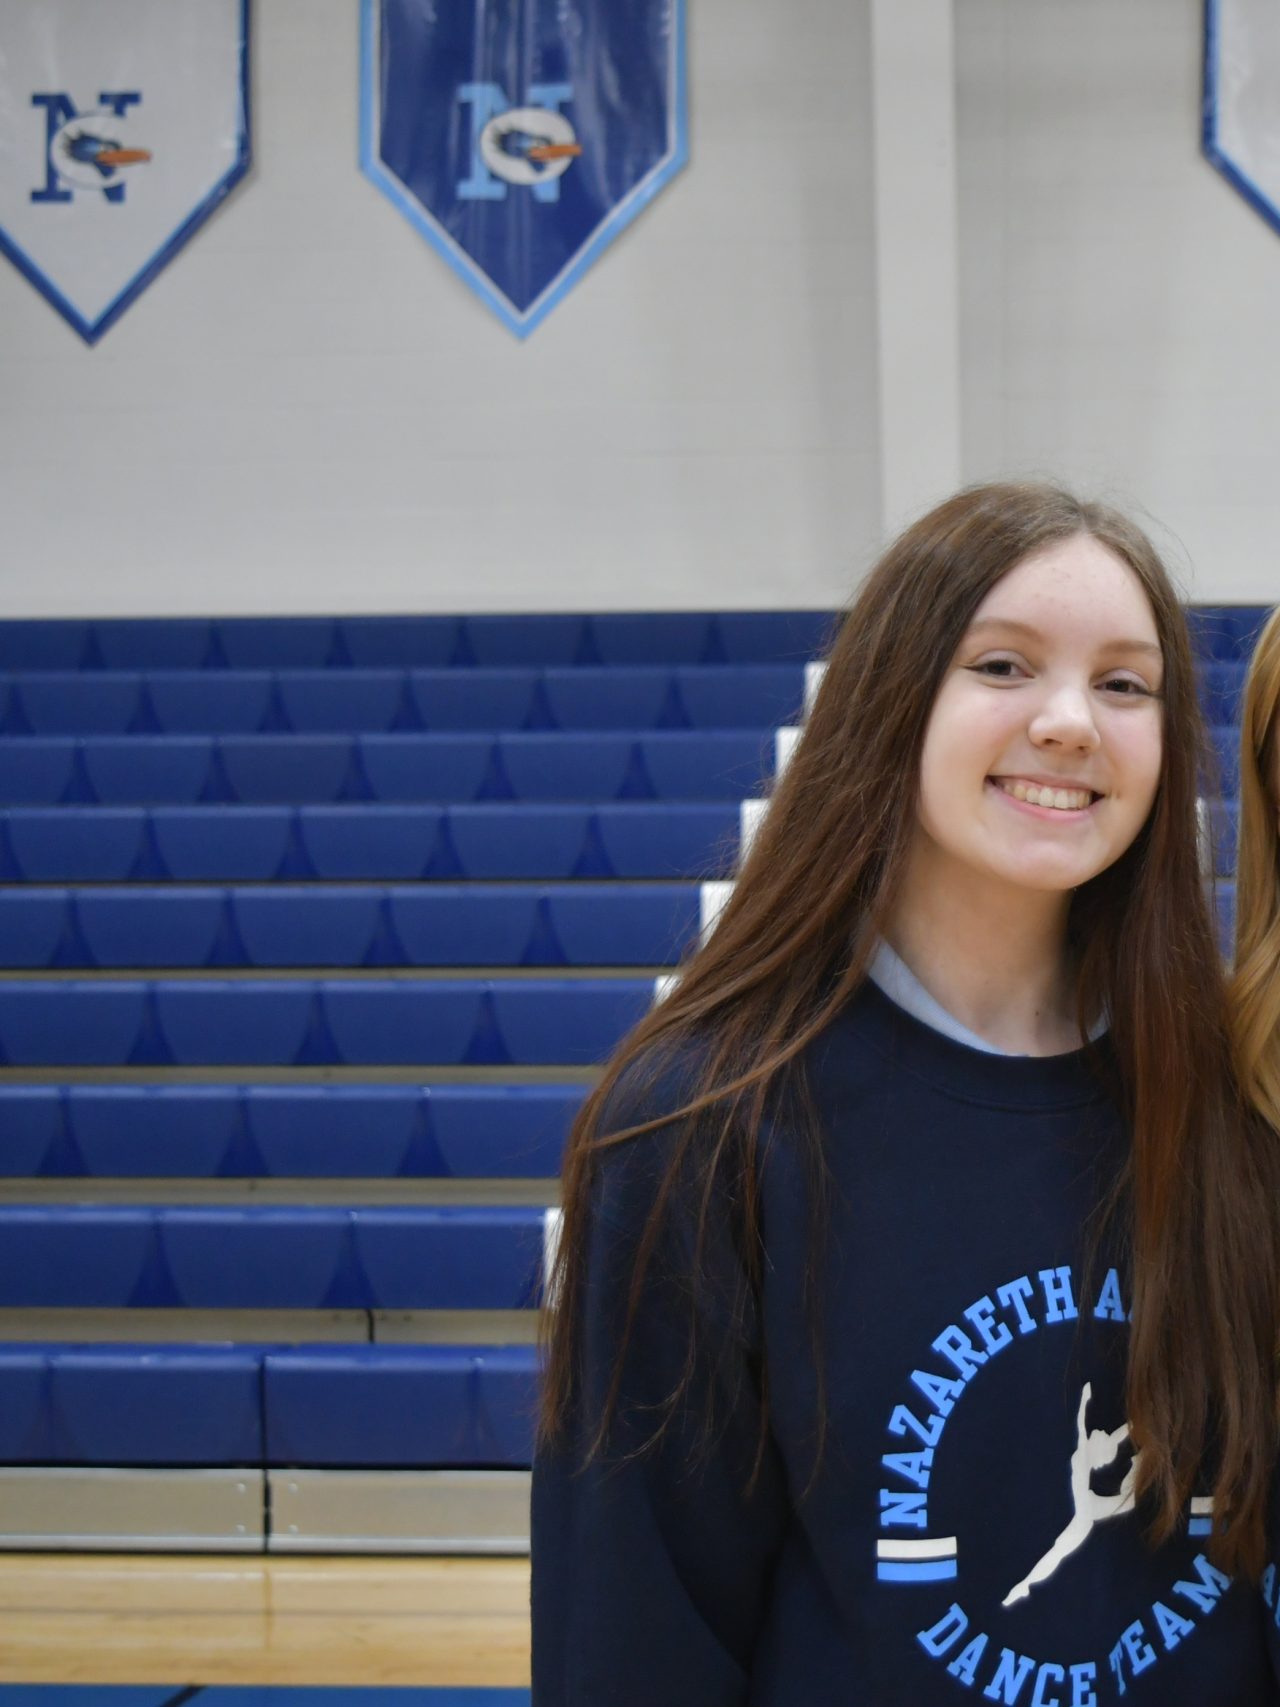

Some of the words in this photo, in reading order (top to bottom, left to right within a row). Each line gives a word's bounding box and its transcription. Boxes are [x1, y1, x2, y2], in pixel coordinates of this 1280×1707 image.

[880, 1265, 1080, 1528] NAZARETH
[916, 1602, 1098, 1707] DANCE
[1109, 1554, 1232, 1696] TEAM
